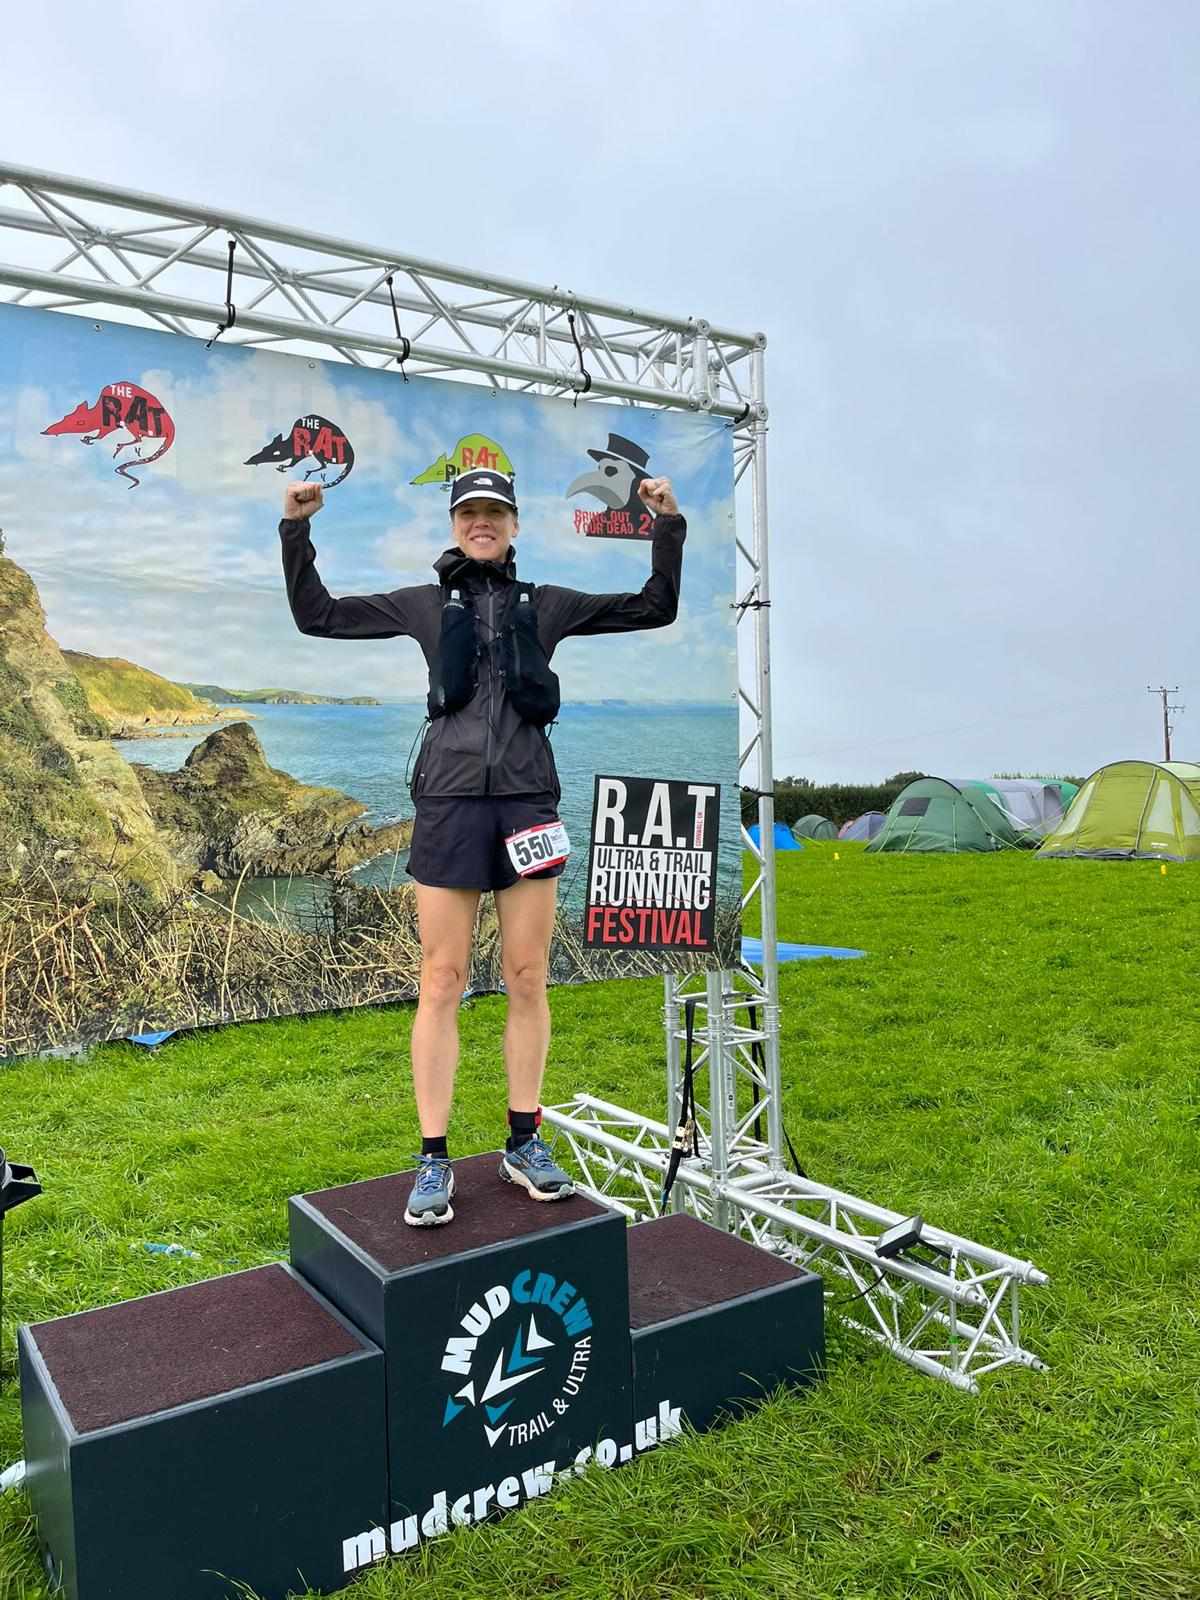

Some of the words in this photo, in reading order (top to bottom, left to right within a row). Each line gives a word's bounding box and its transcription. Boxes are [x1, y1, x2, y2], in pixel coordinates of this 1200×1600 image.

[111, 384, 133, 397] THE
[101, 395, 164, 437] RAT
[302, 418, 320, 429] THE
[293, 426, 346, 464] RAT
[462, 446, 499, 470] RAT
[574, 521, 603, 534] YOUR
[607, 522, 634, 534] DEAD
[610, 511, 631, 522] OUT
[513, 833, 554, 866] 550
[597, 847, 644, 870] ULTRA
[649, 850, 660, 871] &
[664, 851, 708, 874] TRAIL
[589, 870, 711, 911] RUNNING
[587, 907, 708, 945] FESTIVAL
[508, 1412, 556, 1447] TRAIL
[552, 1398, 570, 1415] &
[562, 1335, 592, 1396] ULTRA
